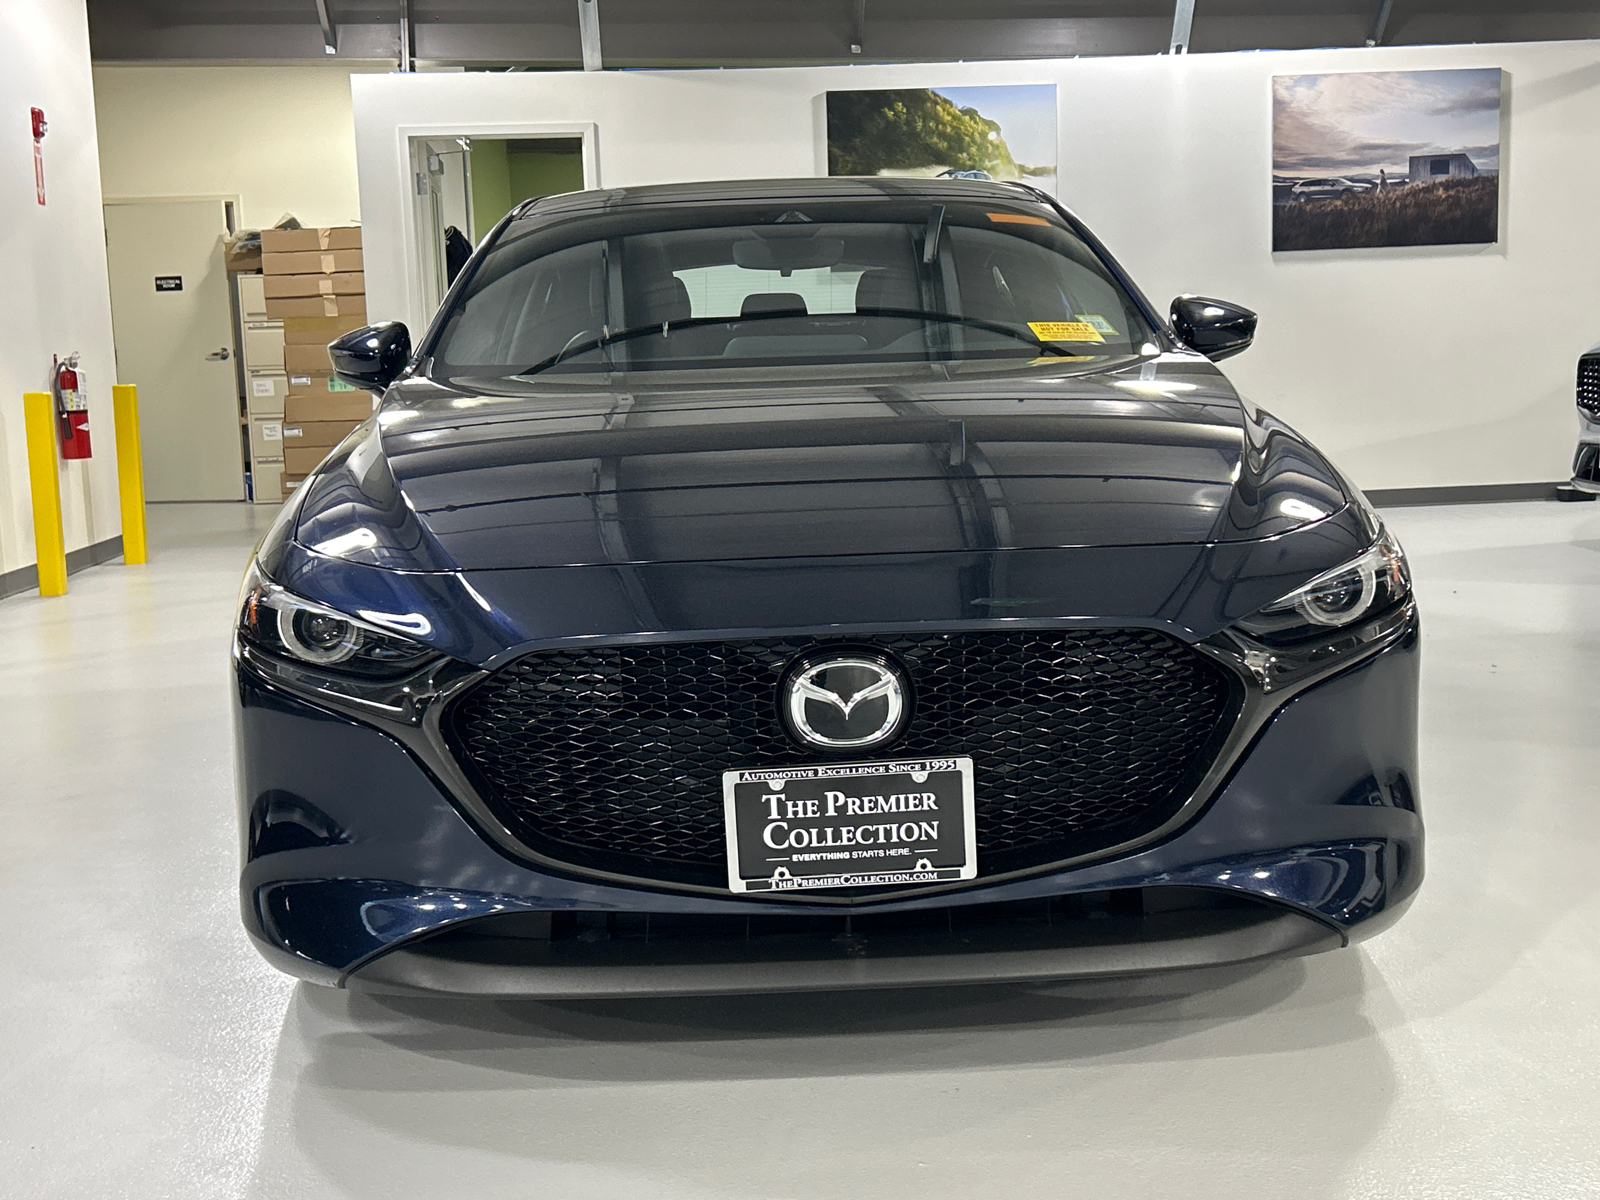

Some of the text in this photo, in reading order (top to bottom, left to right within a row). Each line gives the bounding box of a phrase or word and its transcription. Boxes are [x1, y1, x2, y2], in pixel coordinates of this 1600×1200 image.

[742, 770, 815, 781] AUTOMOTIVE
[817, 765, 886, 777] EXCELLENCE
[925, 760, 956, 771] 1995
[761, 791, 939, 820] THE PREMIER
[762, 820, 940, 850] COLLECTION
[791, 847, 912, 862] EVERYTHING STARTS HERE.
